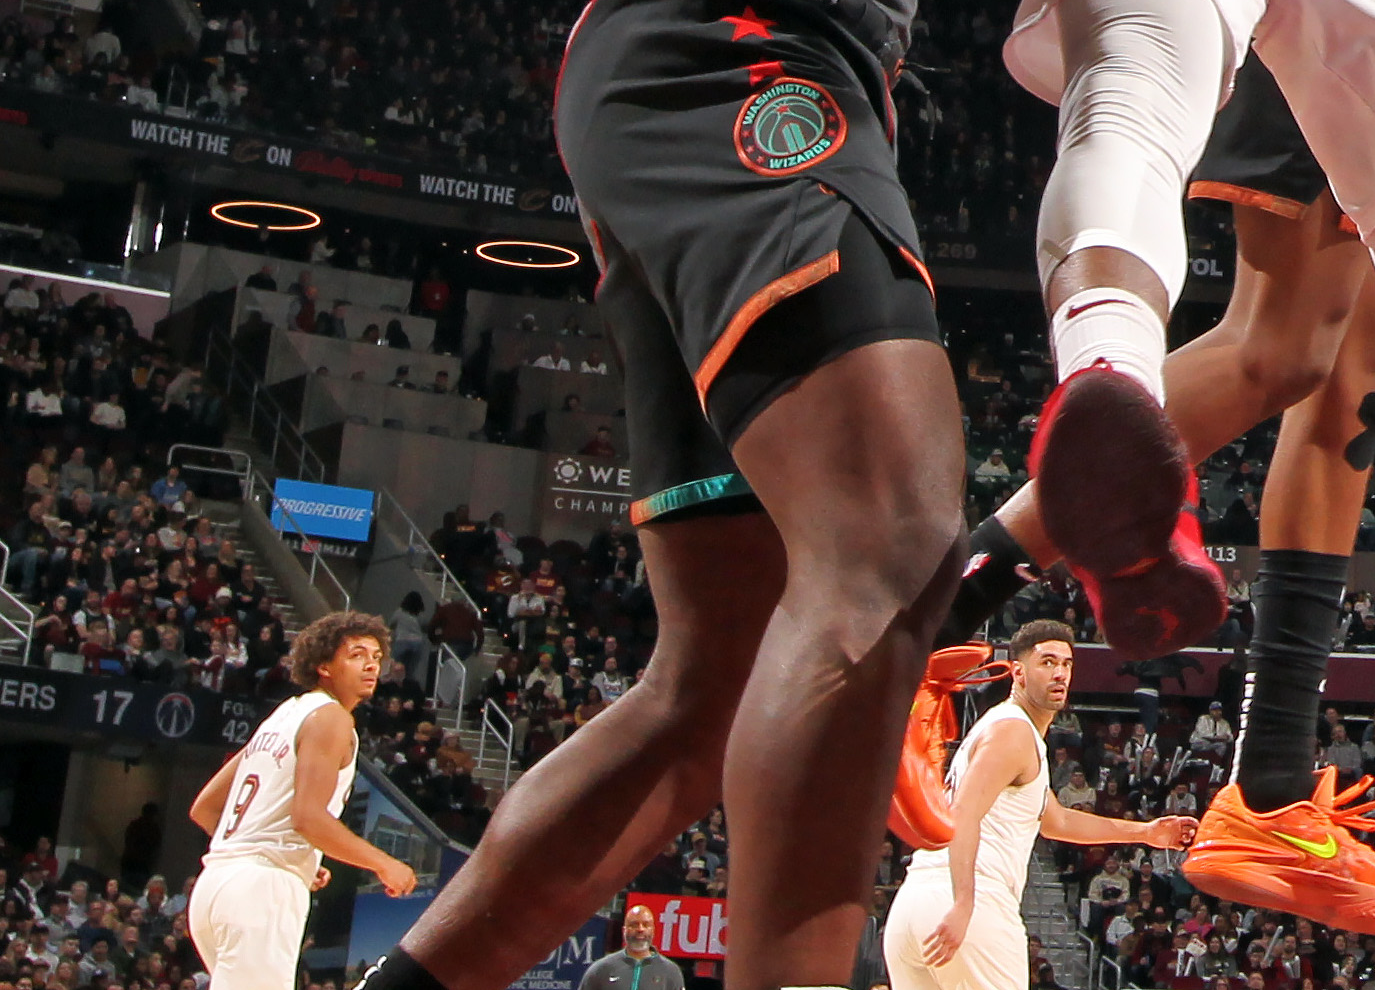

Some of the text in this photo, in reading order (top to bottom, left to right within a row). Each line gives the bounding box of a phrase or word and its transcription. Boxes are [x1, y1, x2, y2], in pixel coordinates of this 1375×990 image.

[743, 83, 821, 125] WASHINGTON
[130, 119, 292, 166] WATCH THE ON
[768, 138, 832, 170] WIZARDS
[419, 174, 580, 216] WATCH THE ON
[1188, 257, 1224, 278] OL
[273, 496, 369, 523] PROGRESSIVE
[553, 497, 629, 514] CHAMP
[1201, 546, 1237, 563] 113
[0, 678, 134, 726] ERS 17
[222, 719, 250, 744] 42
[223, 773, 260, 841] 9
[660, 900, 728, 955] fub
